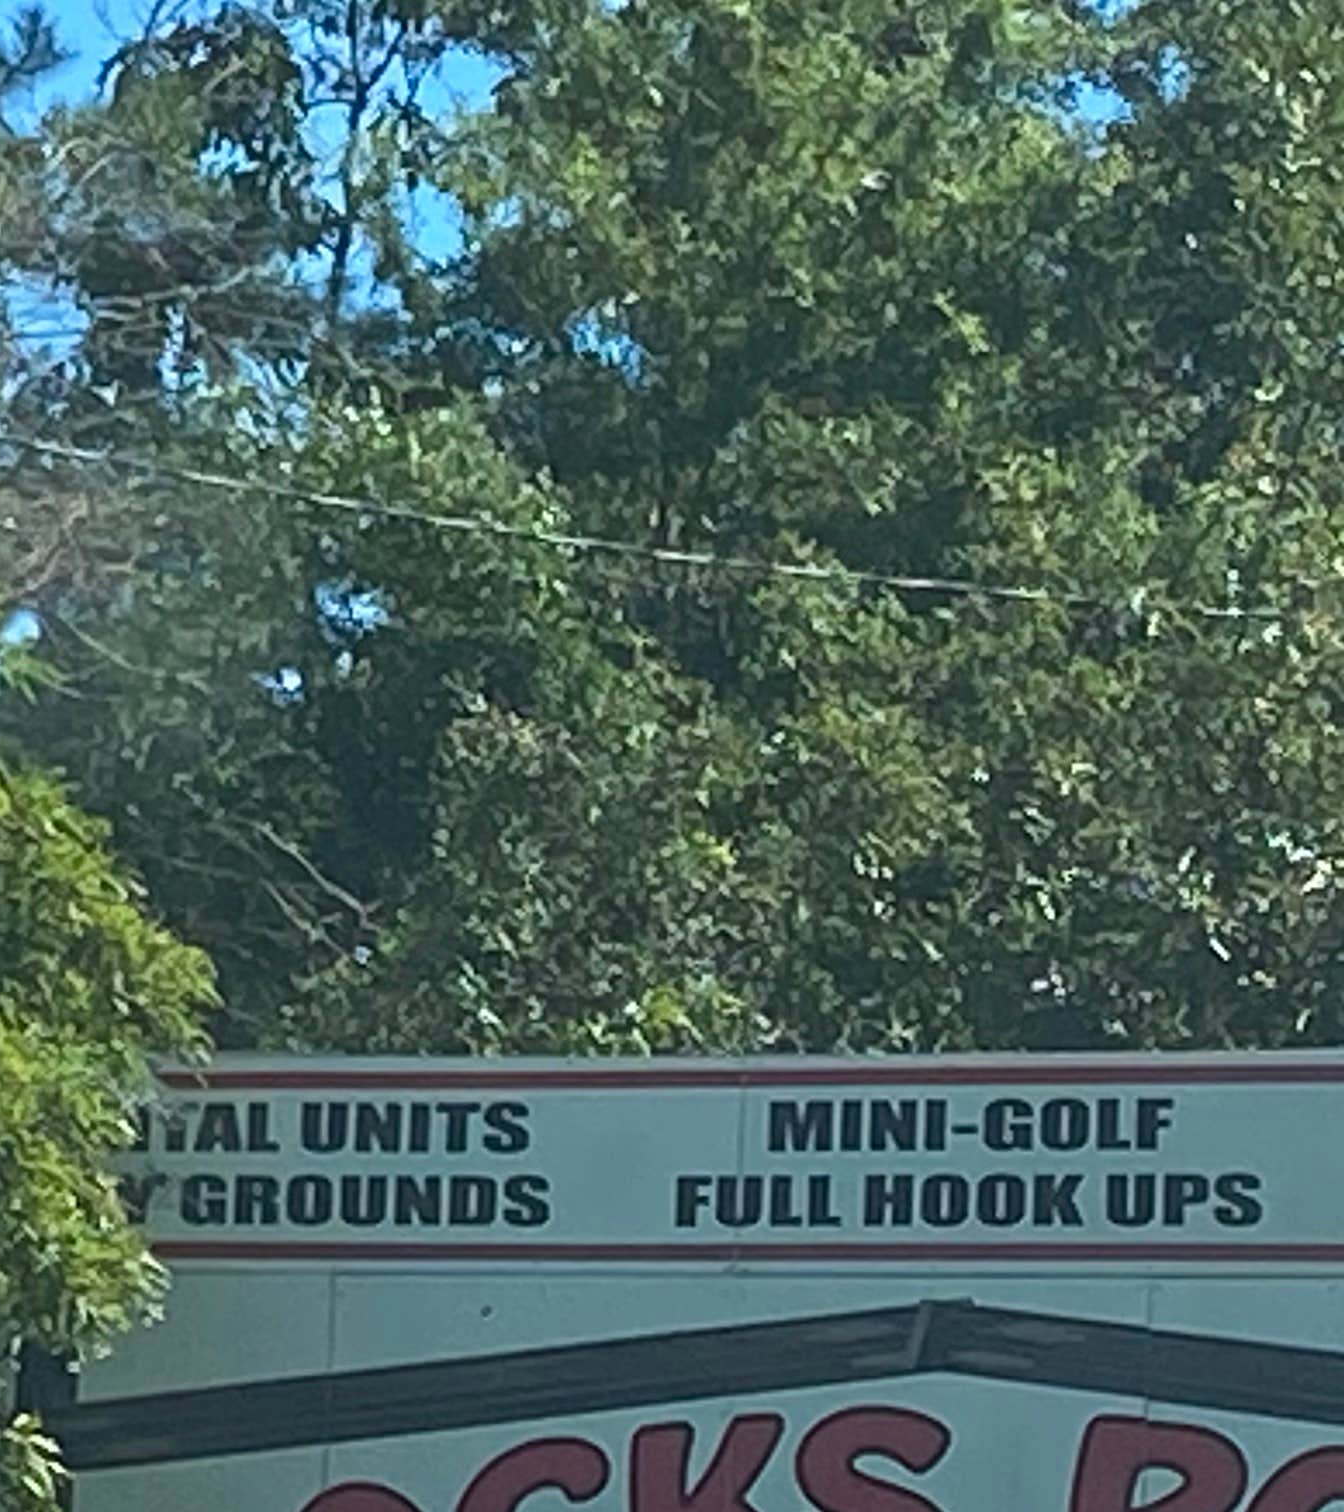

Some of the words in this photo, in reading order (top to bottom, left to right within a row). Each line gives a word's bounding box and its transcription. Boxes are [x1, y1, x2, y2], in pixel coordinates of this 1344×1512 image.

[300, 1101, 530, 1154] UNITS
[767, 1097, 1175, 1153] MINI-GOLF
[178, 1173, 552, 1229] GROUNDS
[674, 1174, 843, 1228] FULL
[863, 1173, 1086, 1228] HOOK
[1103, 1171, 1264, 1228] UPS
